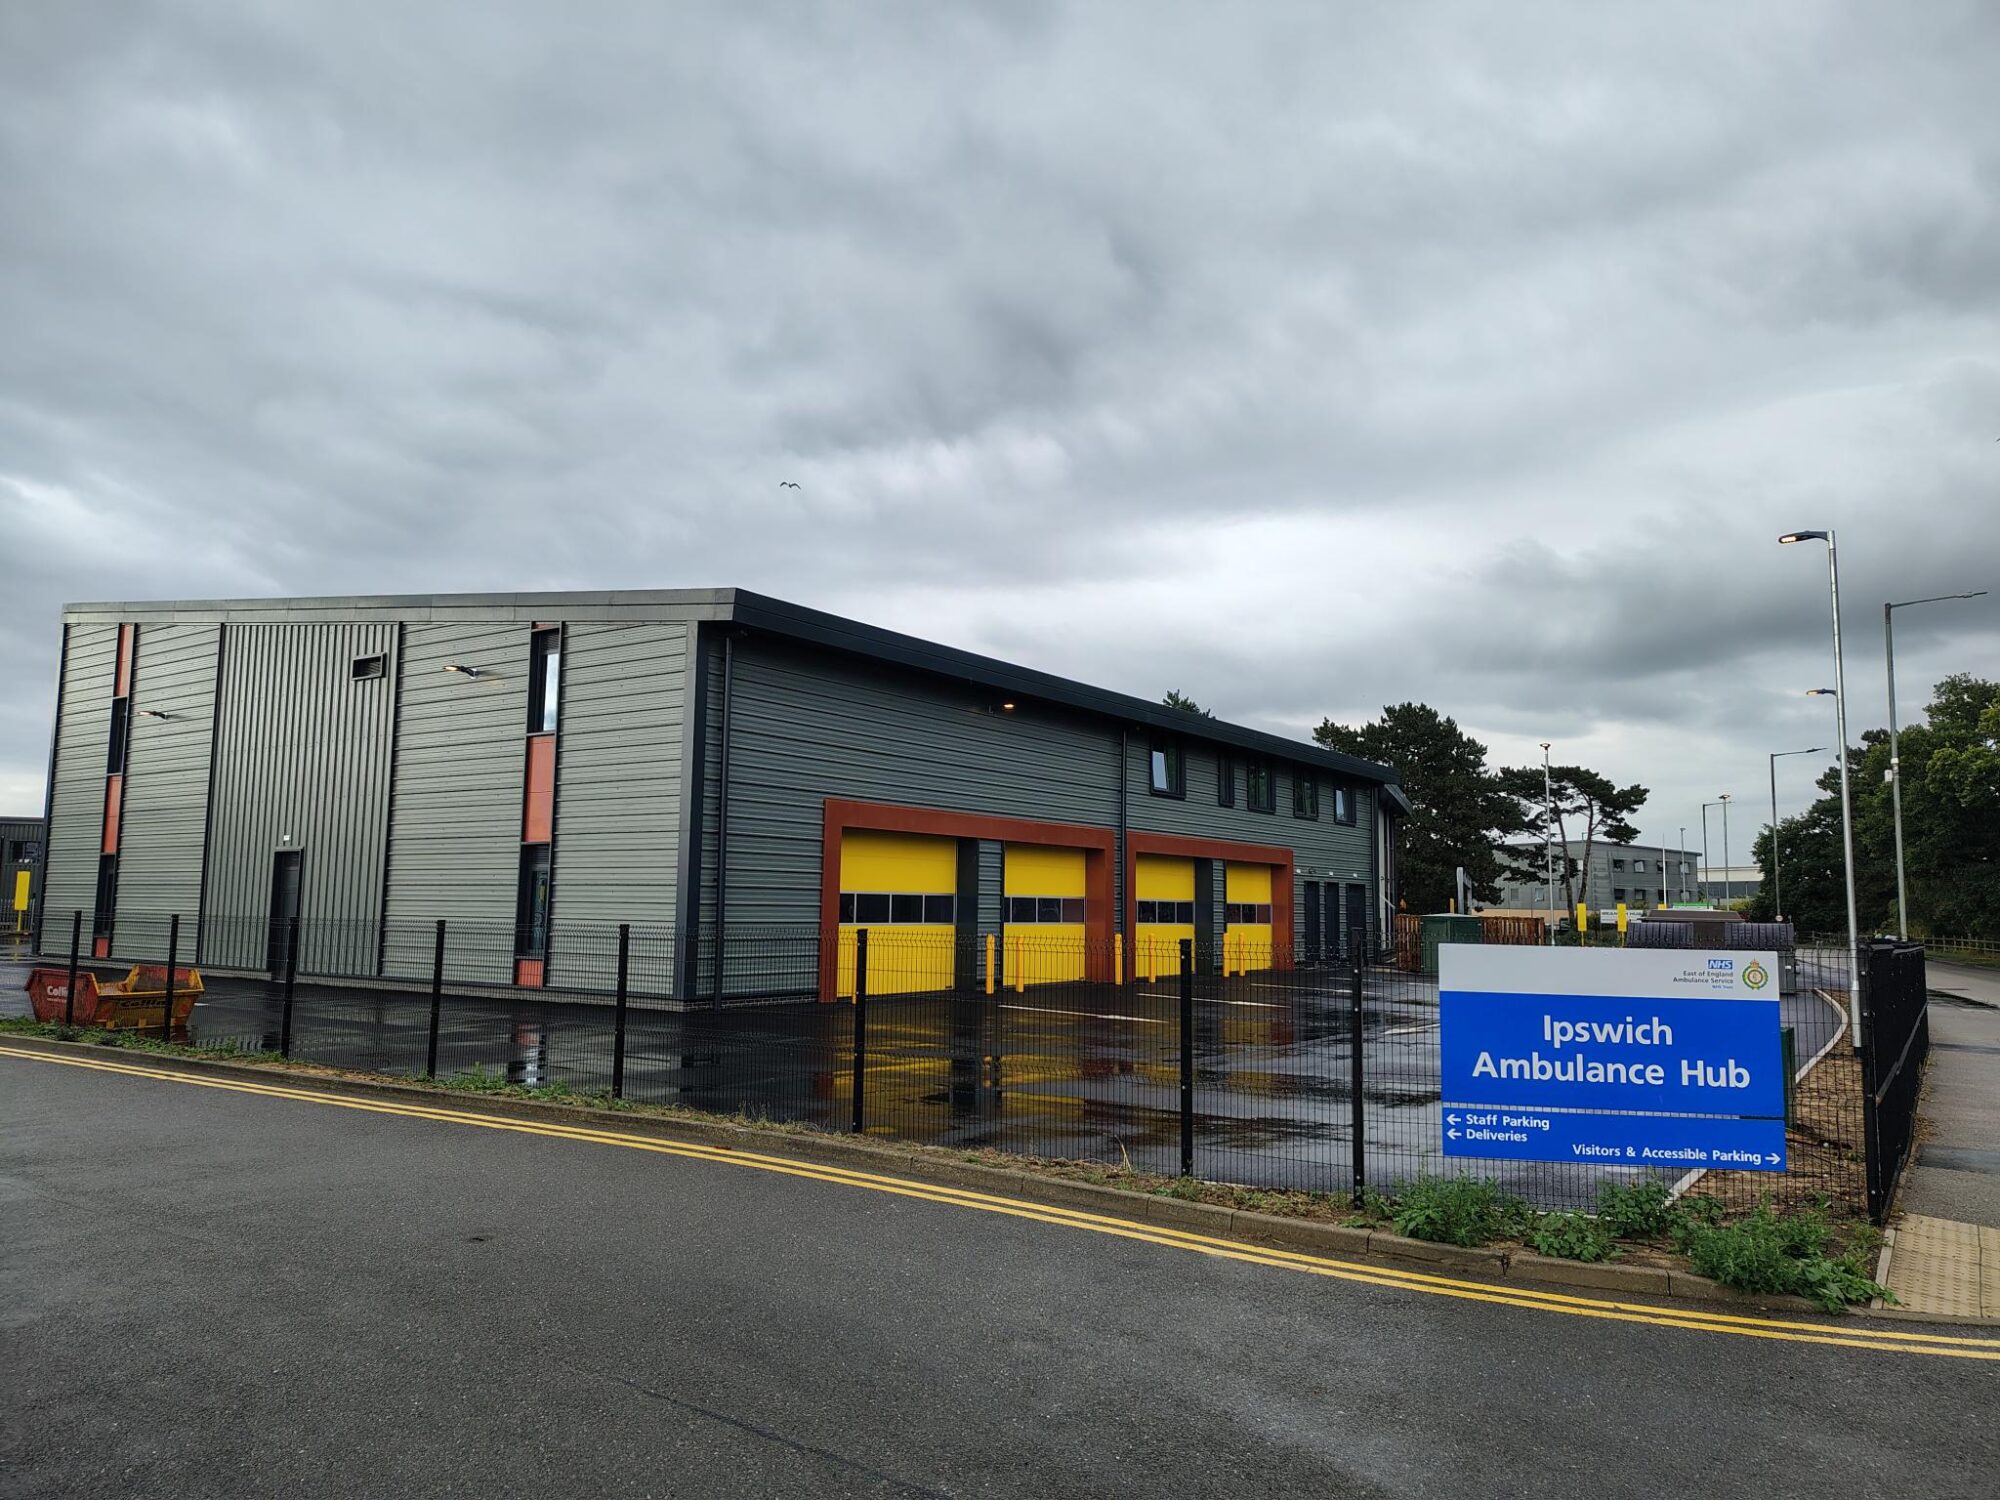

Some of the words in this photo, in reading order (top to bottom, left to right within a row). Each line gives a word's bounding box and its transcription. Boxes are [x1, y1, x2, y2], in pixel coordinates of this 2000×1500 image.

[1709, 960, 1733, 969] NHS
[1543, 1015, 1673, 1049] Ipswich
[1472, 1051, 1665, 1085] Ambulance
[1681, 1059, 1751, 1089] Hub
[1466, 1113, 1498, 1126] Staff
[1502, 1115, 1550, 1131] Parking
[1466, 1128, 1528, 1142] Deliveries
[1572, 1144, 1621, 1157] Visitors
[1626, 1146, 1636, 1157] &
[1642, 1147, 1708, 1160] Accessible
[1712, 1149, 1762, 1166] Parking
